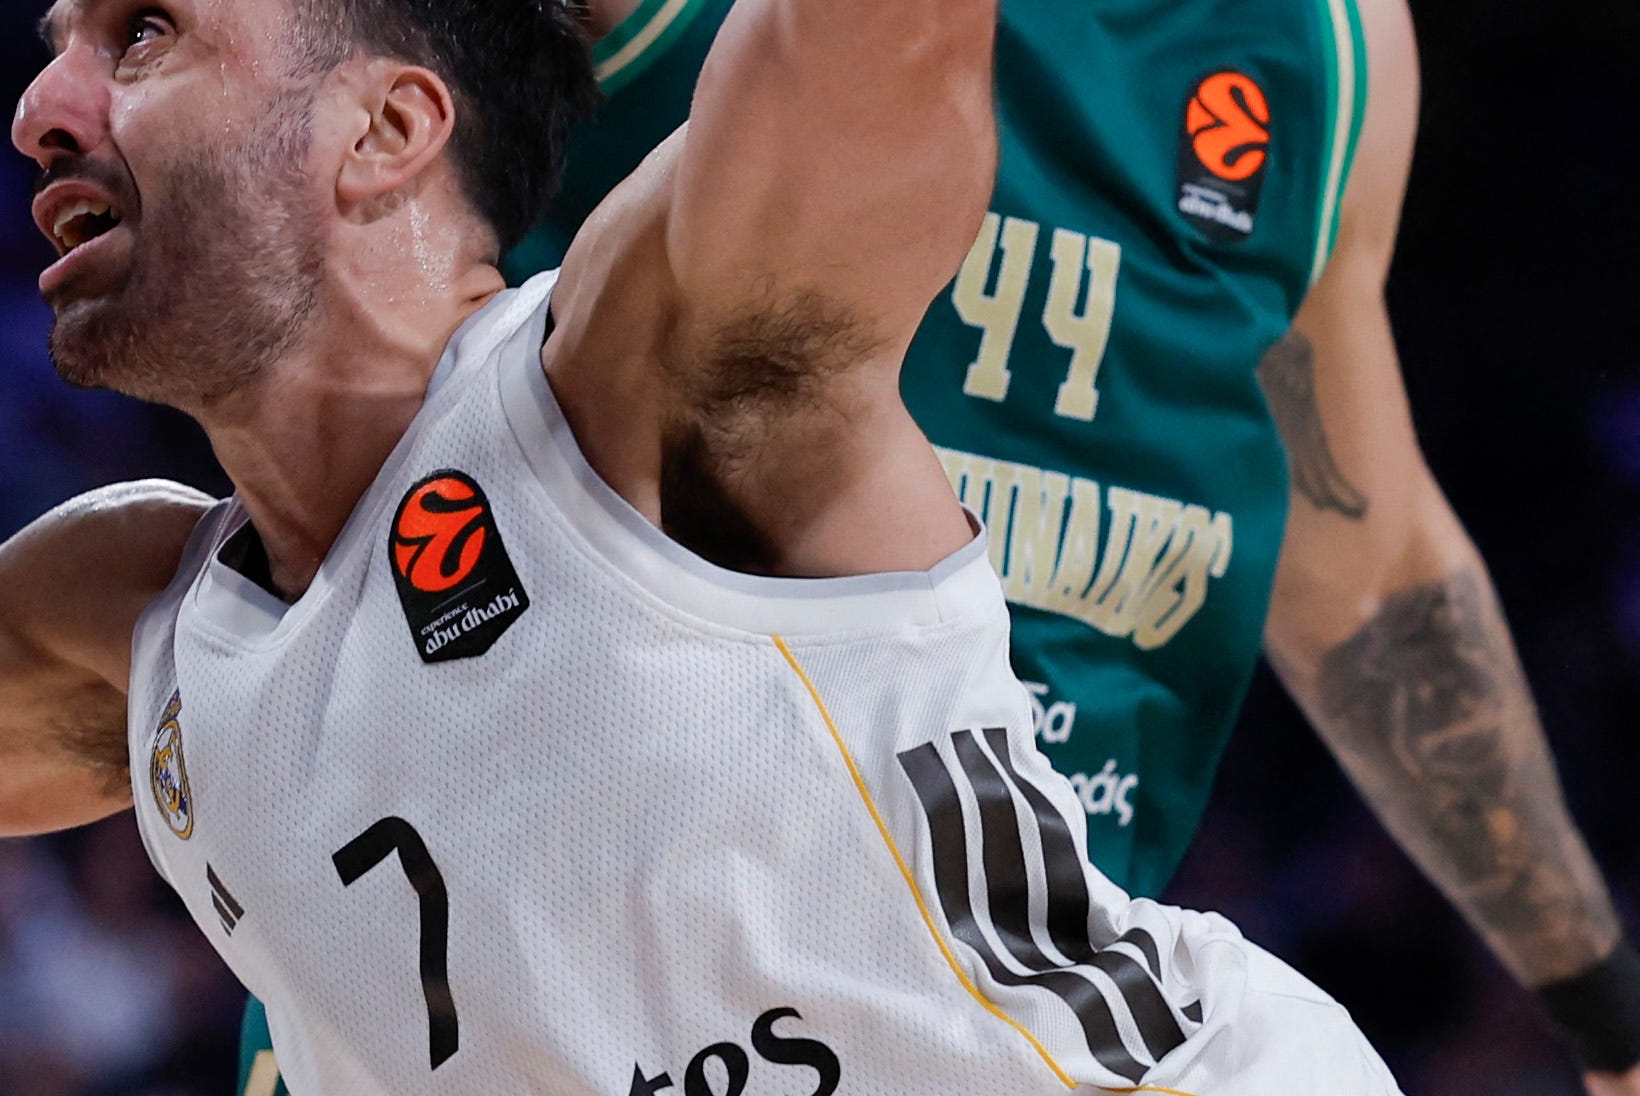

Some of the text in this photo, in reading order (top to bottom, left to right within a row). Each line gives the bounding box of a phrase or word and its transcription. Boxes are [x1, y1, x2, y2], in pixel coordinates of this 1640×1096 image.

[951, 212, 1122, 422] 44
[420, 602, 469, 636] experience
[424, 587, 520, 655] abu dhabi
[331, 815, 460, 1072] 7
